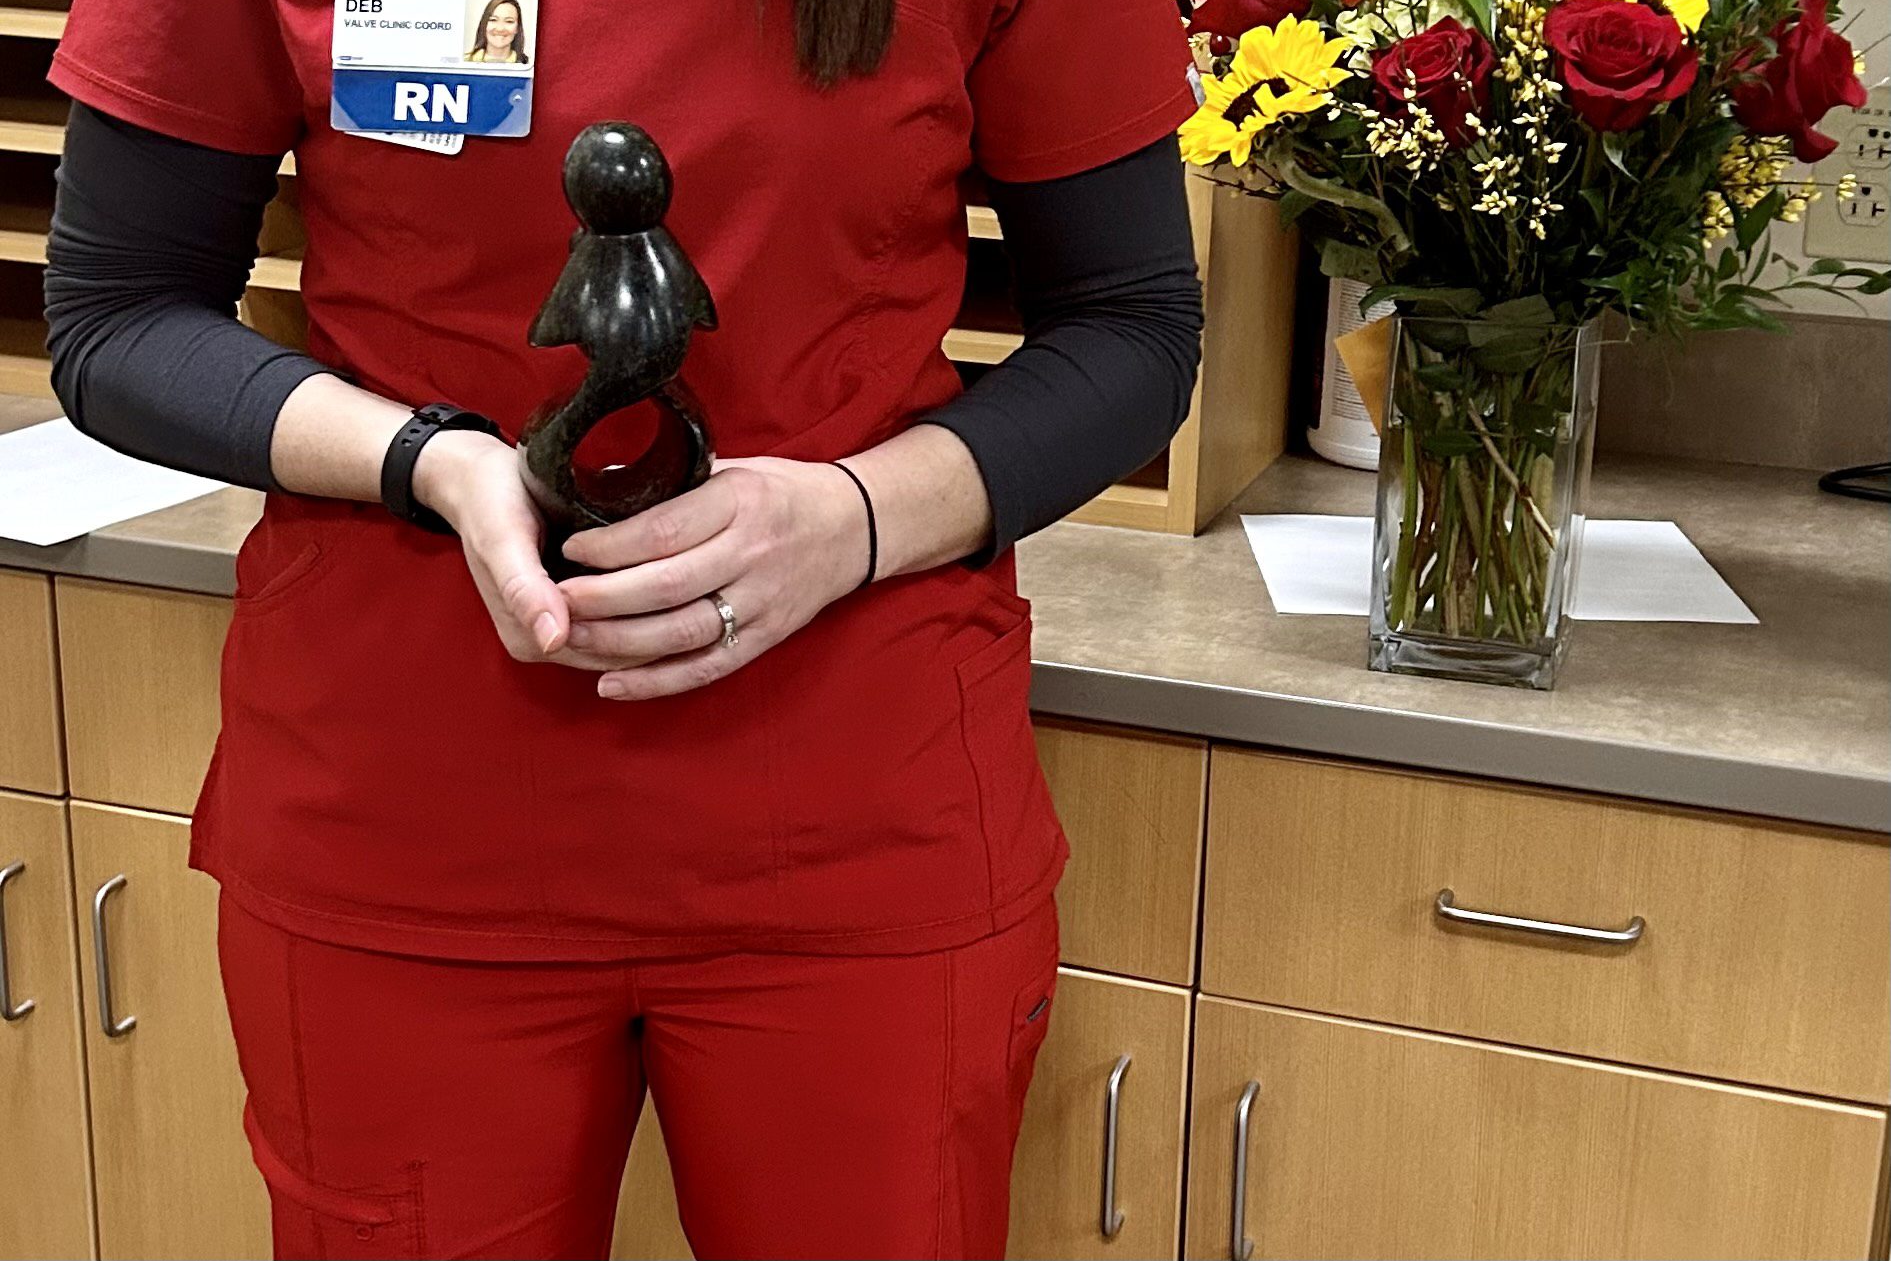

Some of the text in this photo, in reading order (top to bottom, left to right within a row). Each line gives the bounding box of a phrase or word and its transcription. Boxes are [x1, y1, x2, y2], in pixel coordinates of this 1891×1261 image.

[344, 19, 452, 31] VALVE CLINIC COORD
[394, 82, 470, 123] RN
